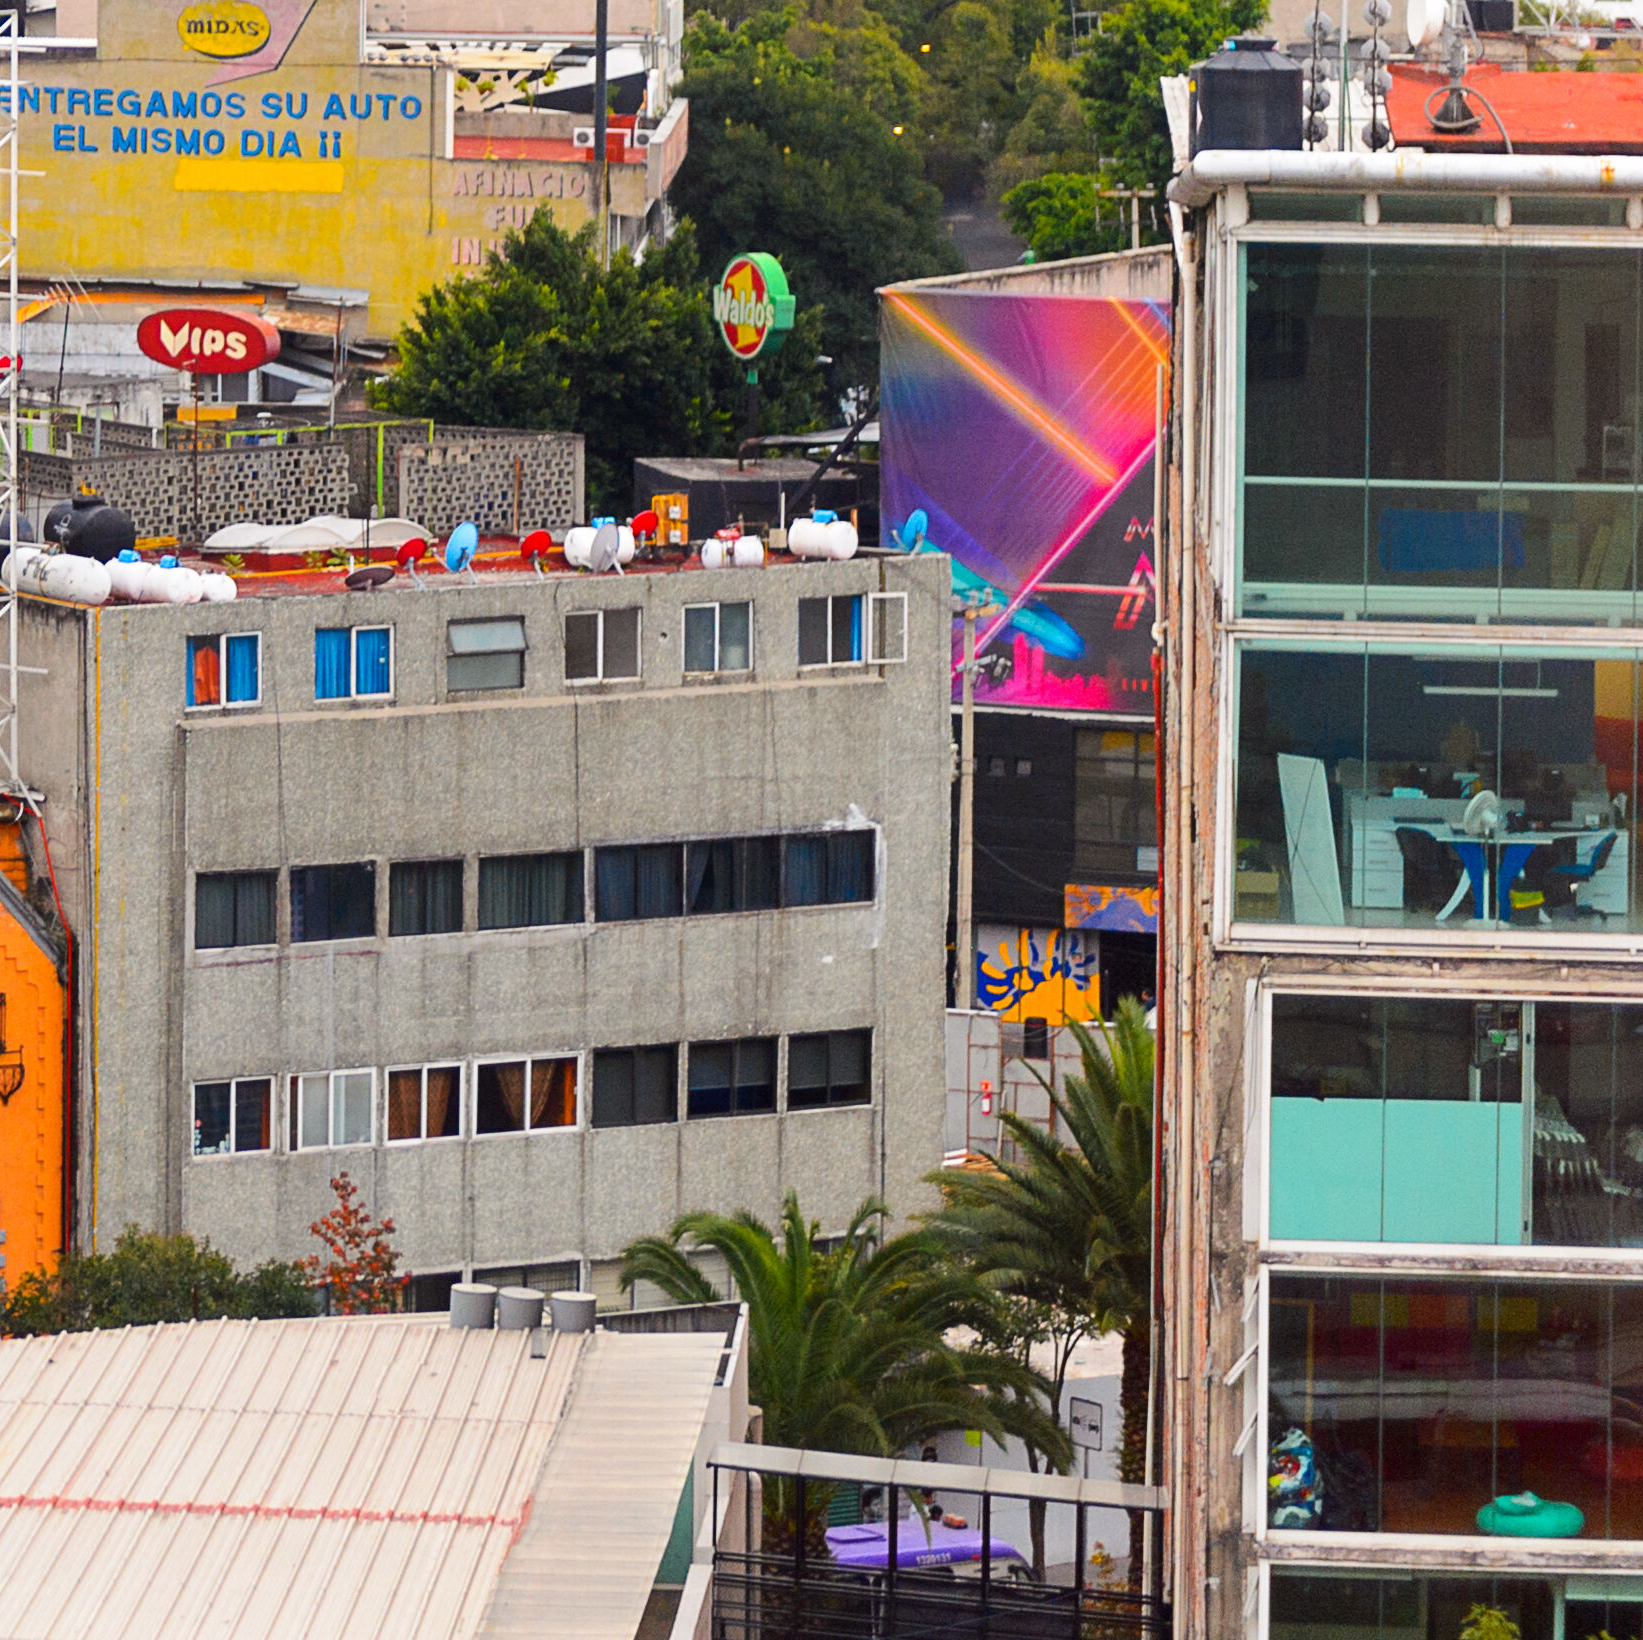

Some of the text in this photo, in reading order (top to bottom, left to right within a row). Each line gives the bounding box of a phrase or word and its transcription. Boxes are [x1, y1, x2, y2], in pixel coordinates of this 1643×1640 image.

[187, 19, 259, 36] MIDAS
[0, 86, 422, 121] ENTREGAMOS SU AUTO
[53, 123, 97, 153] EL
[111, 127, 224, 156] MISMO
[241, 129, 303, 158] DIA
[713, 286, 774, 328] Waldo's
